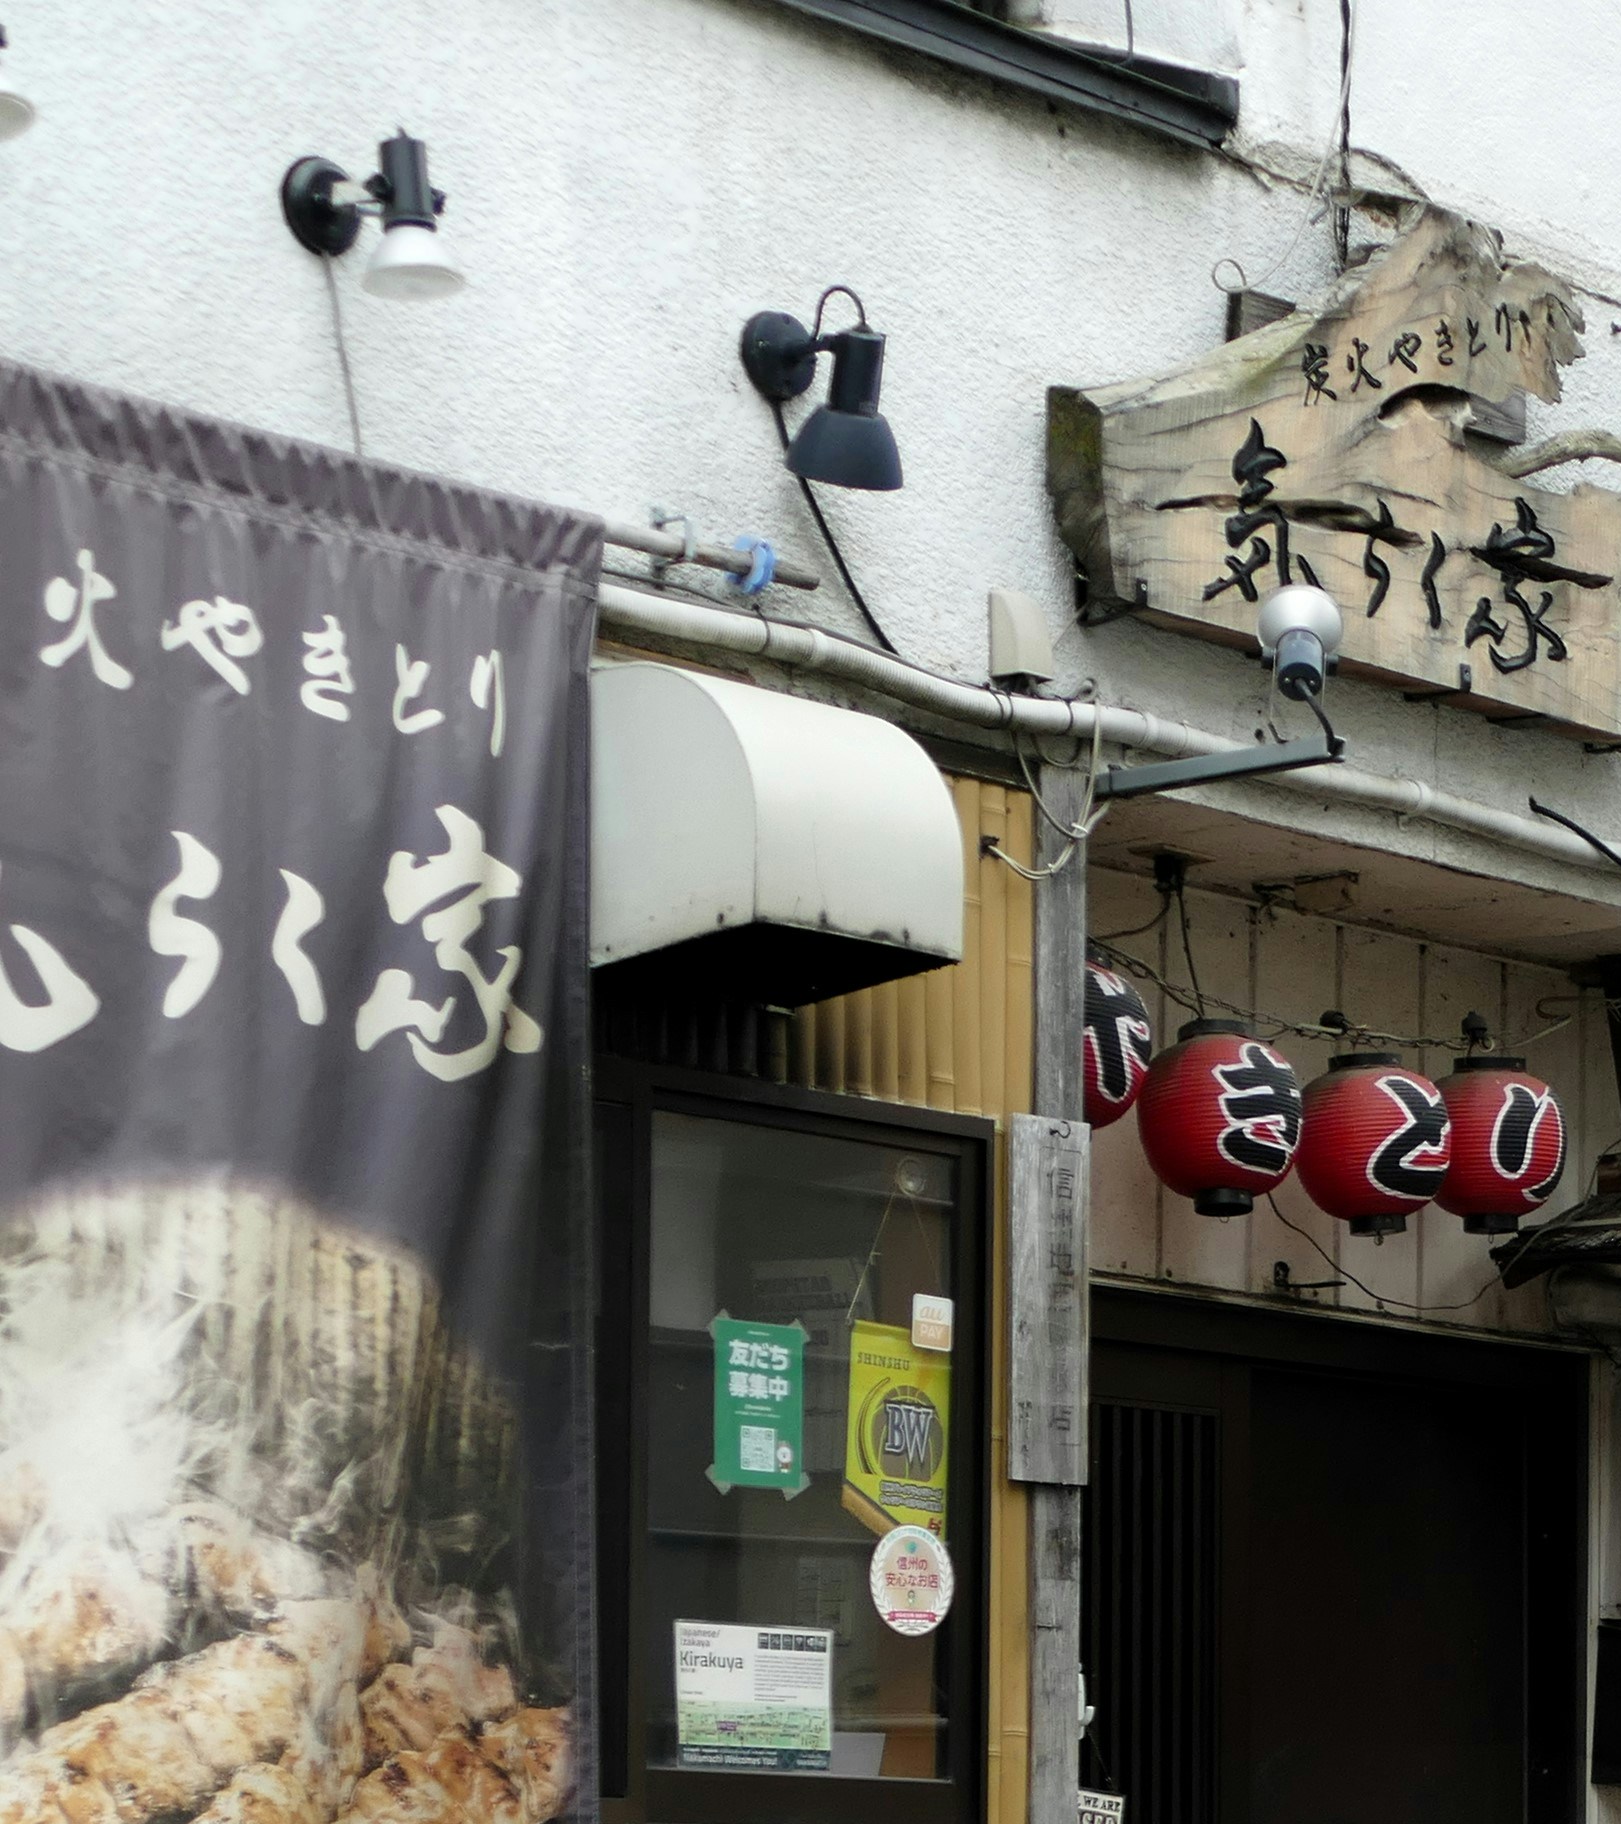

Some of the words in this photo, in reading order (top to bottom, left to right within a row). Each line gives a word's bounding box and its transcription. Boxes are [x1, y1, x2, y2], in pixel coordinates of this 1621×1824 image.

[1302, 302, 1531, 406] 炭火やきとり
[40, 548, 505, 757] 火やきとり
[920, 1323, 945, 1339] PAY
[728, 1339, 789, 1371] 友だち
[857, 1352, 911, 1371] SHINSHU
[728, 1371, 789, 1402] 募集中
[885, 1403, 934, 1463] BW
[896, 1556, 928, 1571] 信州の
[884, 1571, 939, 1589] 安心なお店
[679, 1650, 744, 1673] Kirakuya
[1083, 1795, 1099, 1808] WE
[1100, 1799, 1121, 1812] ARE
